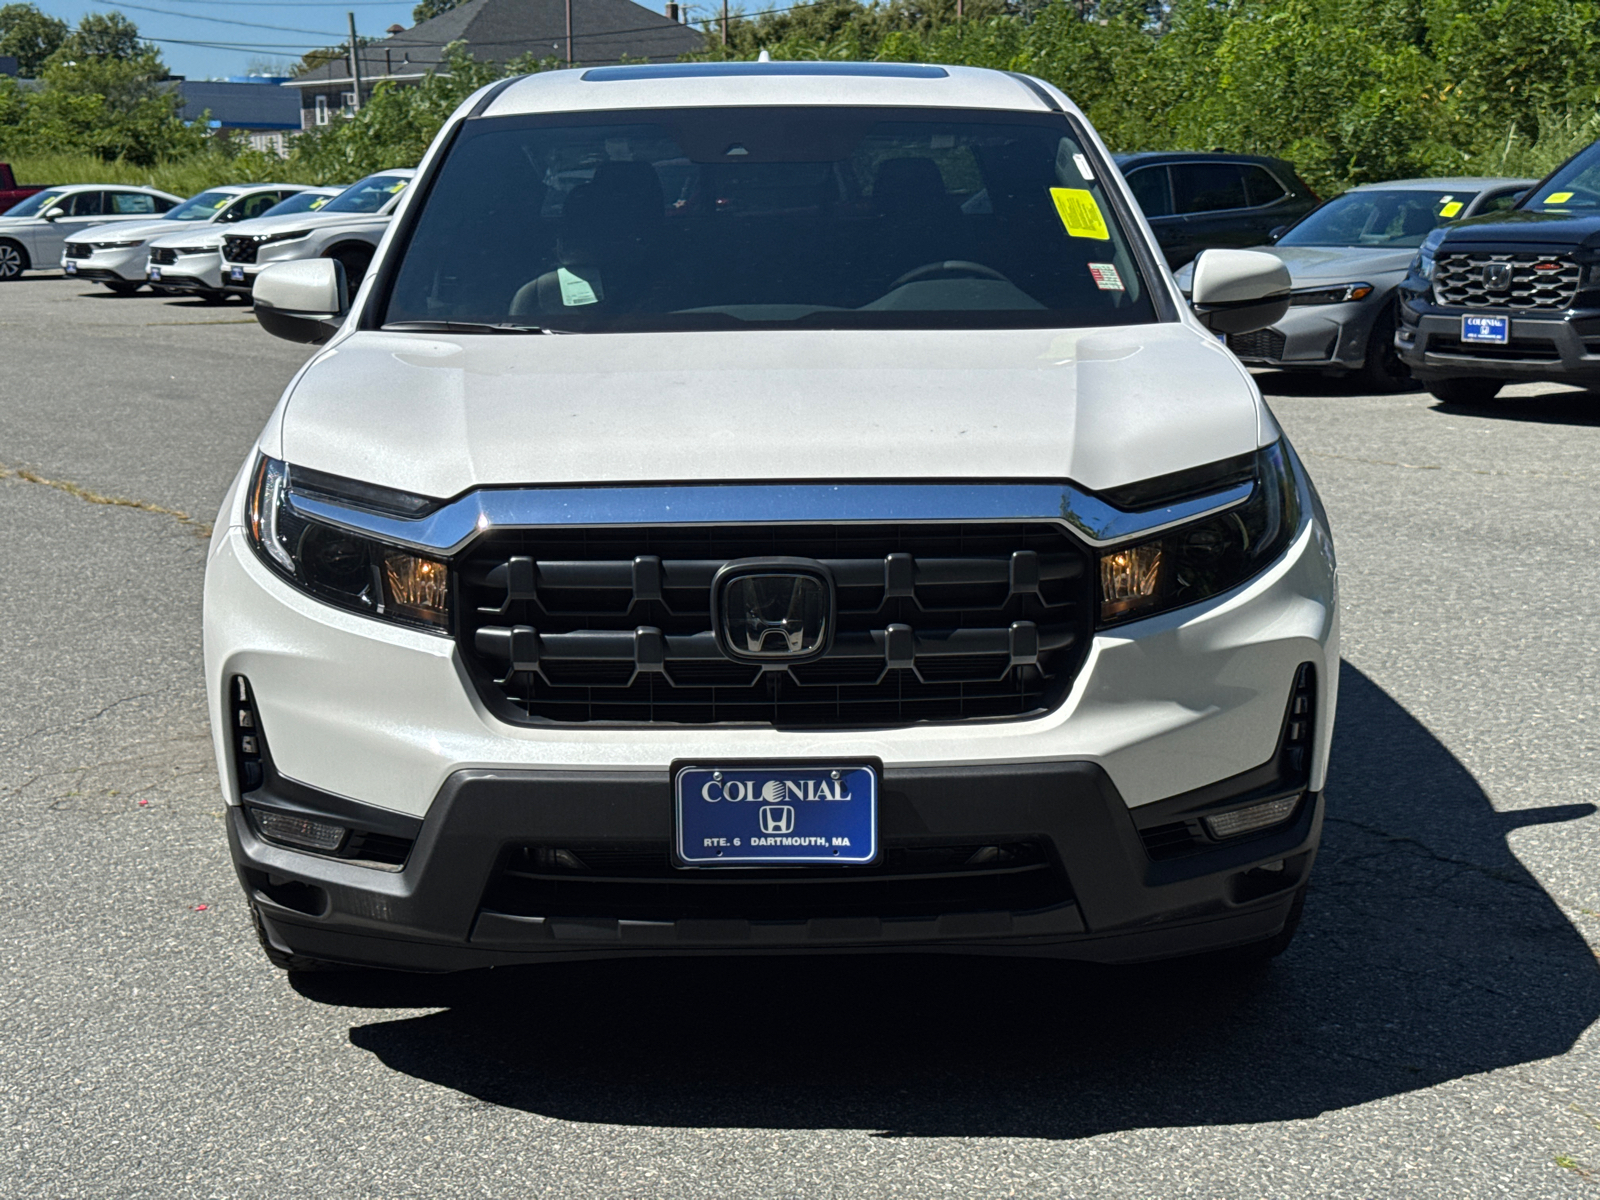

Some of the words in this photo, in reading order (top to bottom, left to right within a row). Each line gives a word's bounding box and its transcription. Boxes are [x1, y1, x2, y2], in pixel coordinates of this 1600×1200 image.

[701, 780, 852, 802] COLONIAL
[703, 837, 731, 847] RTE.
[733, 837, 742, 847] 6
[750, 836, 829, 847] DARTMOUTH,
[831, 837, 851, 846] MA
